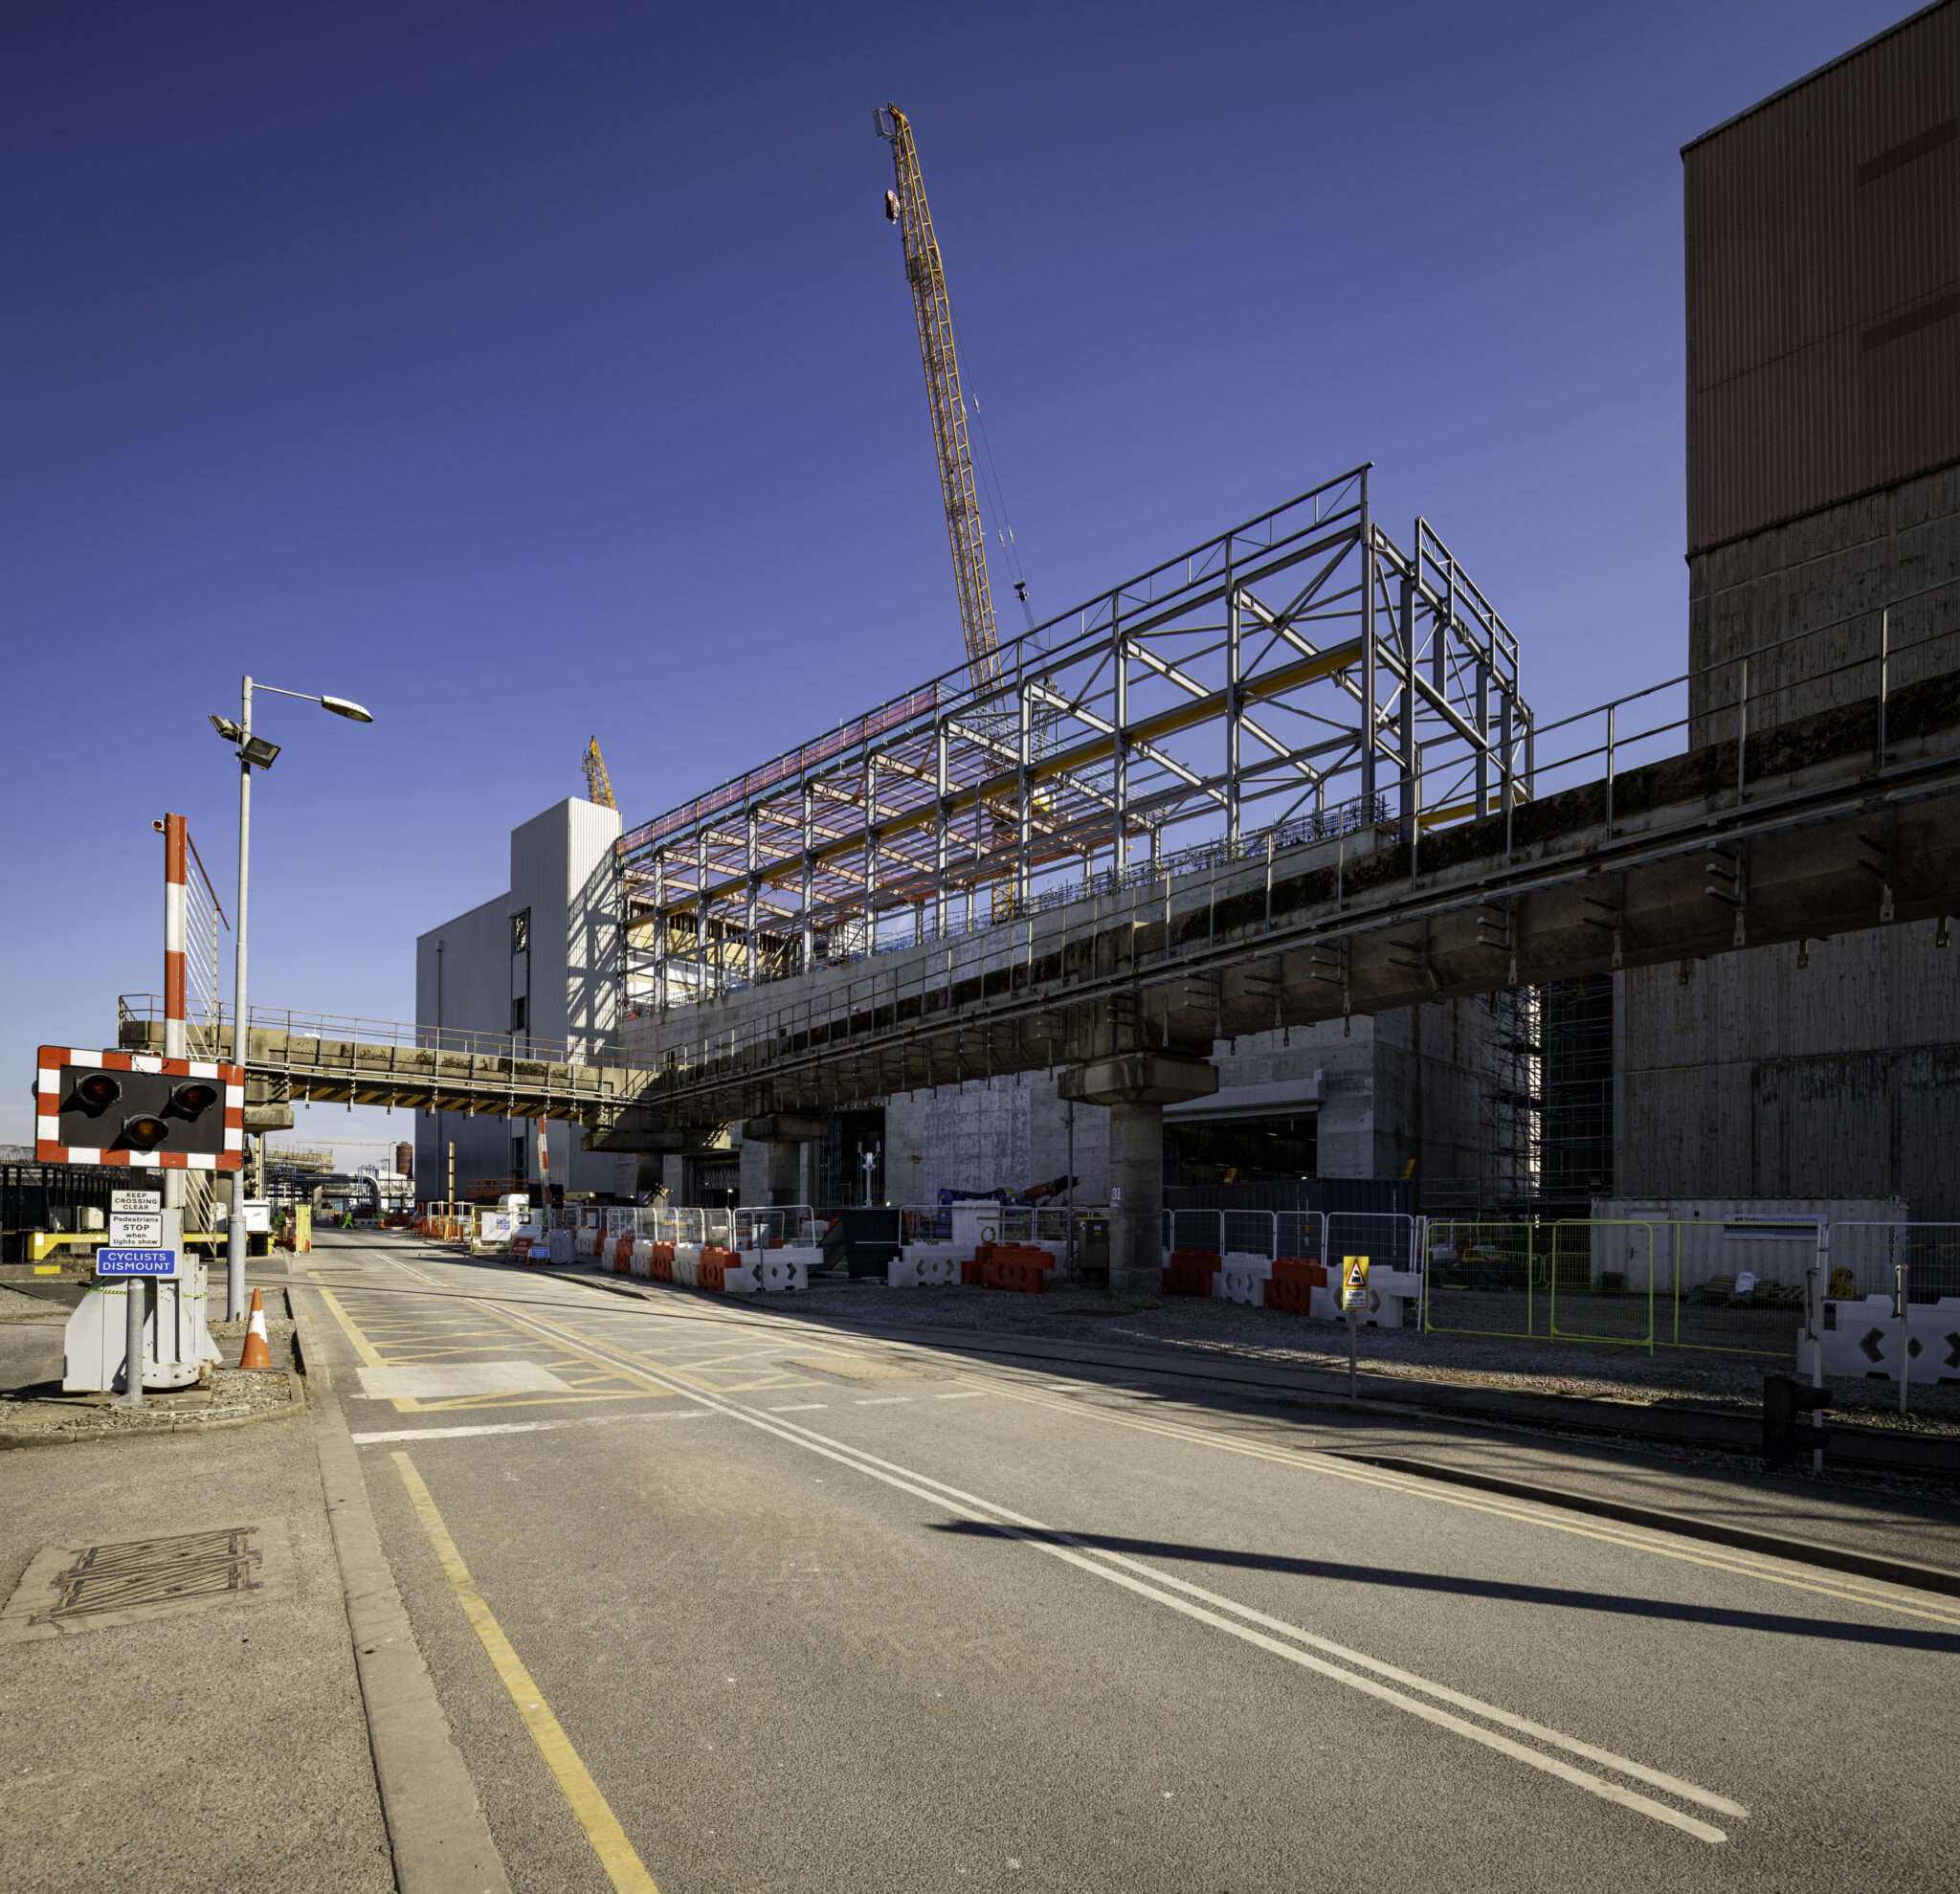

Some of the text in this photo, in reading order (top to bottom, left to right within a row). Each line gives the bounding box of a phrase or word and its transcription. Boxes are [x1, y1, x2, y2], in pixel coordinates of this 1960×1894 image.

[1111, 1187, 1121, 1200] 31
[107, 1252, 167, 1261] CYCLISTS
[102, 1261, 170, 1271] DISMOUNT
